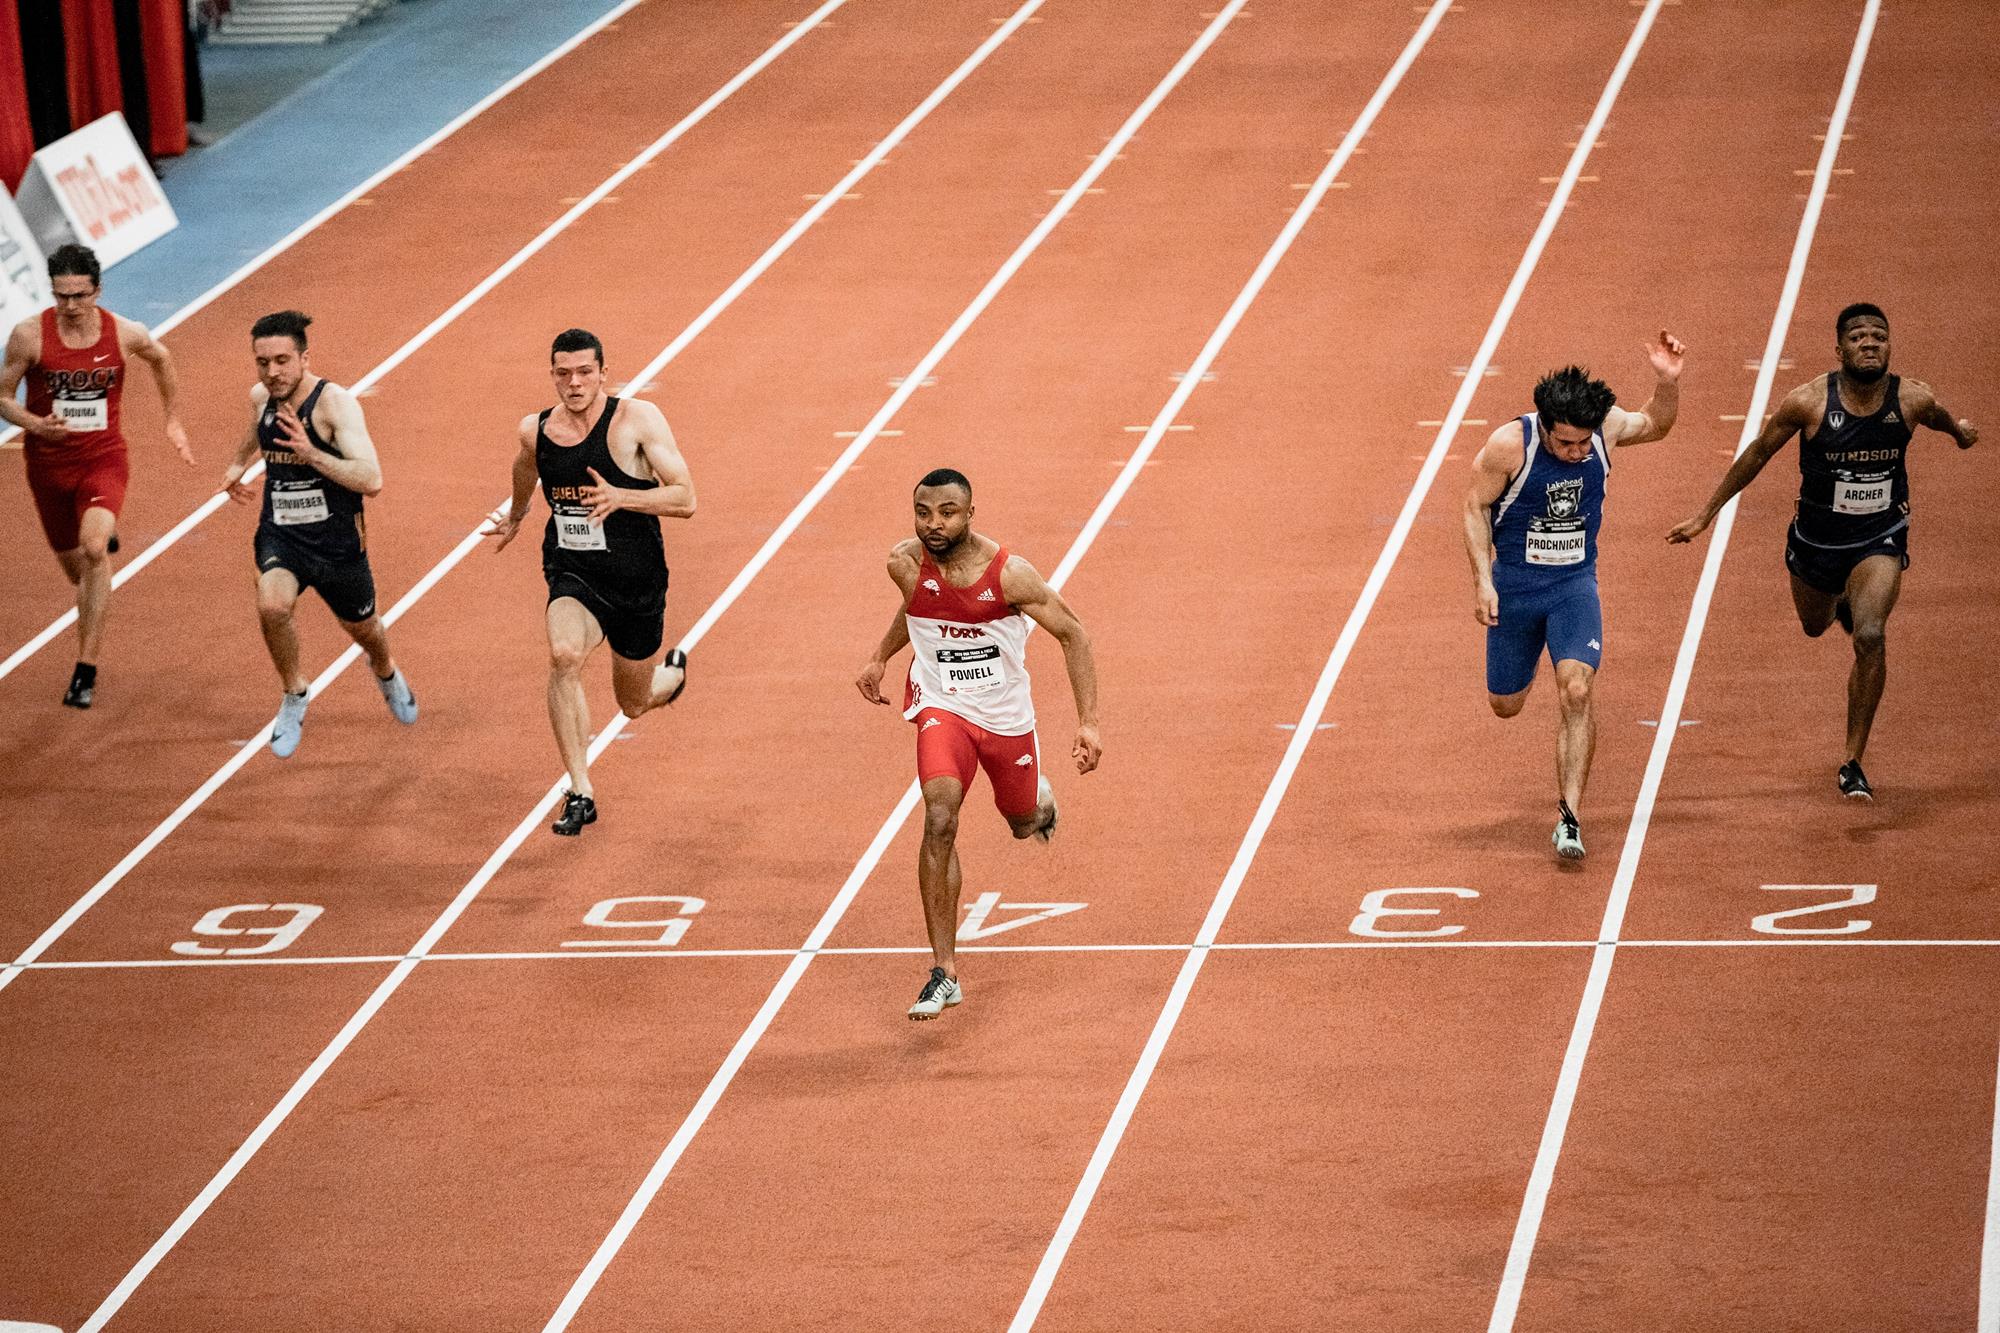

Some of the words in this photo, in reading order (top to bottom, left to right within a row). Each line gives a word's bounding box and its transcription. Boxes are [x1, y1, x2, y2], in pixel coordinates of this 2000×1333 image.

[1825, 448, 1899, 462] WINDSOR
[1546, 476, 1583, 491] Lakehead
[1844, 488, 1884, 501] ARCHER
[563, 523, 590, 536] HENRI
[1528, 537, 1583, 551] PROCHNICKI
[938, 625, 986, 639] YORK
[949, 666, 994, 681] POWELL
[955, 892, 1090, 941] 4
[1348, 887, 1481, 938] 3
[1750, 884, 1878, 935] 2
[560, 895, 707, 948] 5
[171, 903, 325, 956] 6
